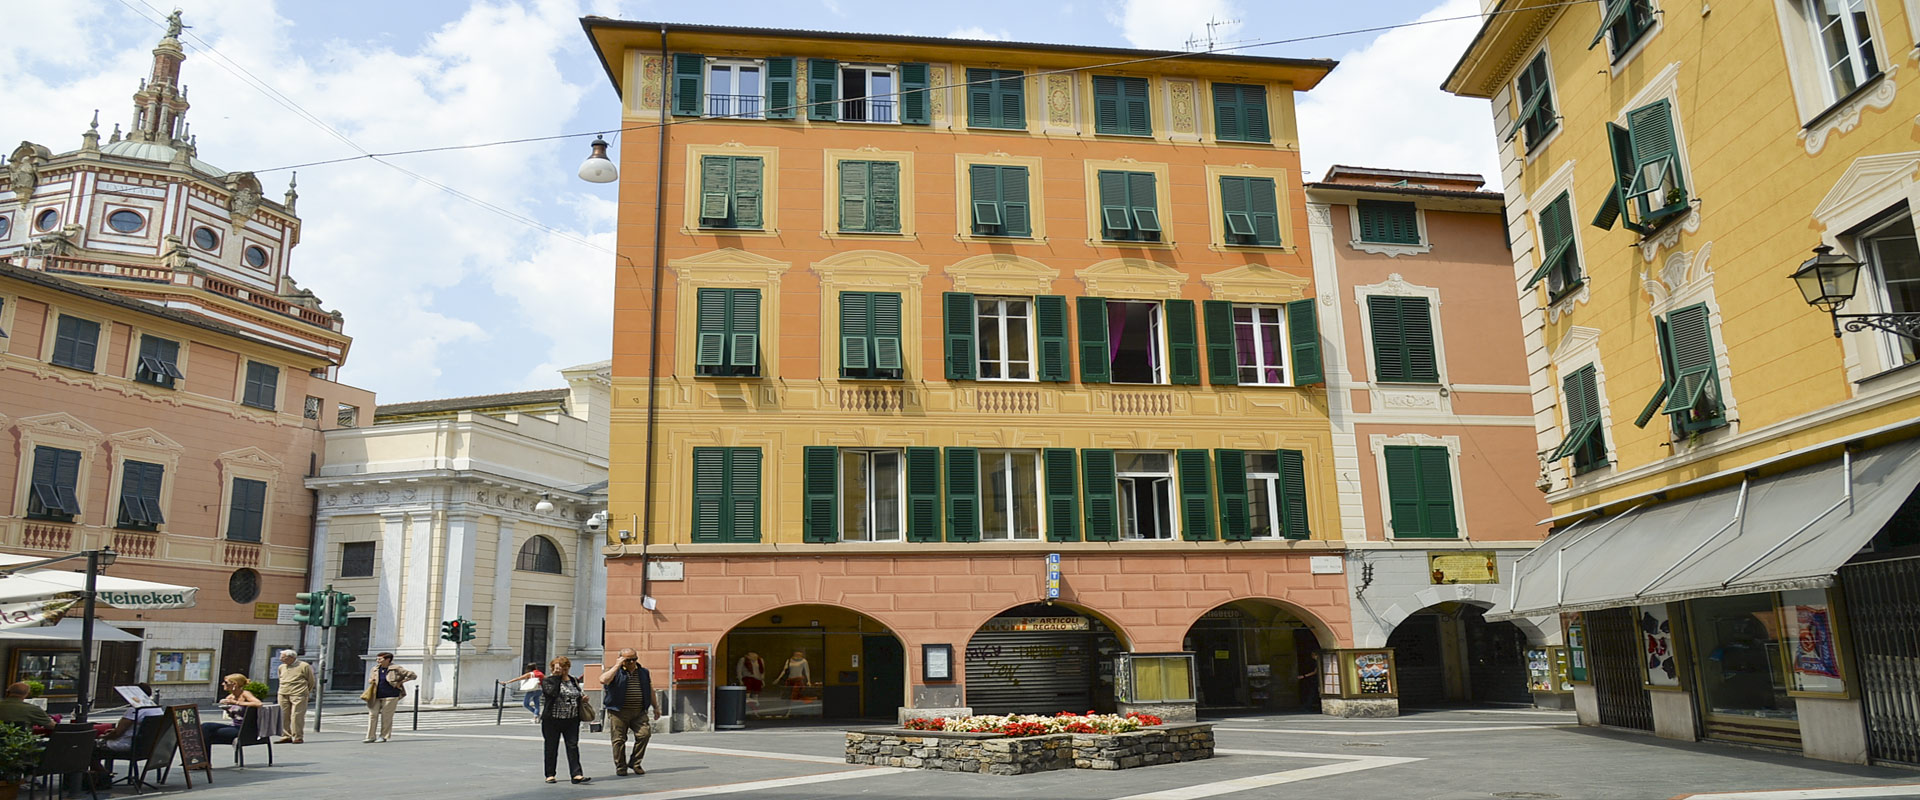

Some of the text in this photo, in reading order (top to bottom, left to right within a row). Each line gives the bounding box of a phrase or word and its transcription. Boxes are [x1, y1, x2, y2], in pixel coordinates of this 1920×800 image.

[1051, 555, 1059, 596] LOTTO
[101, 592, 184, 605] Heineken
[0, 609, 34, 625] ta
